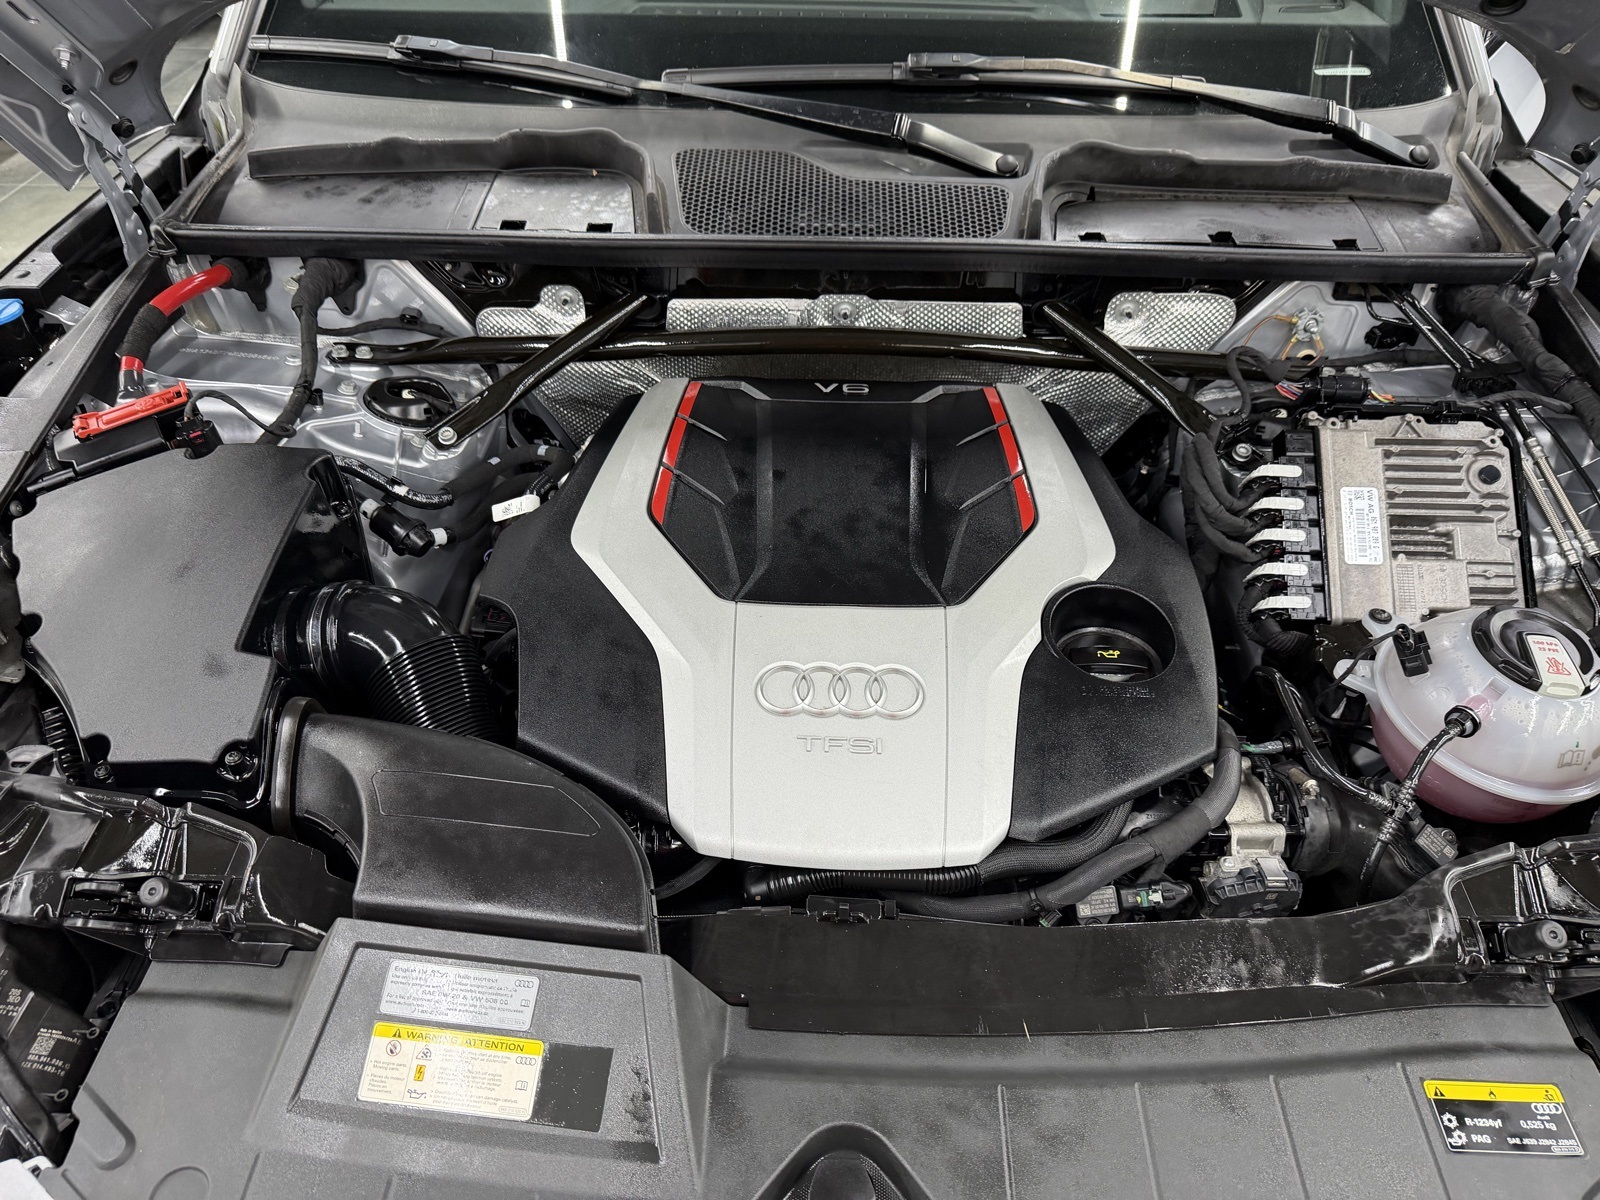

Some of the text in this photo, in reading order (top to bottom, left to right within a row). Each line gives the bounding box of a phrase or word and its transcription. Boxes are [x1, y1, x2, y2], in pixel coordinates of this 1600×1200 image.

[814, 382, 870, 394] V6
[1367, 490, 1373, 501] VW
[1367, 503, 1374, 514] AG
[796, 735, 882, 755] TFSI
[465, 1037, 525, 1052] ATTENTION
[1464, 1117, 1503, 1129] R-1234yf
[1519, 1119, 1557, 1131] 0,525 kg
[1470, 1134, 1492, 1144] PAG
